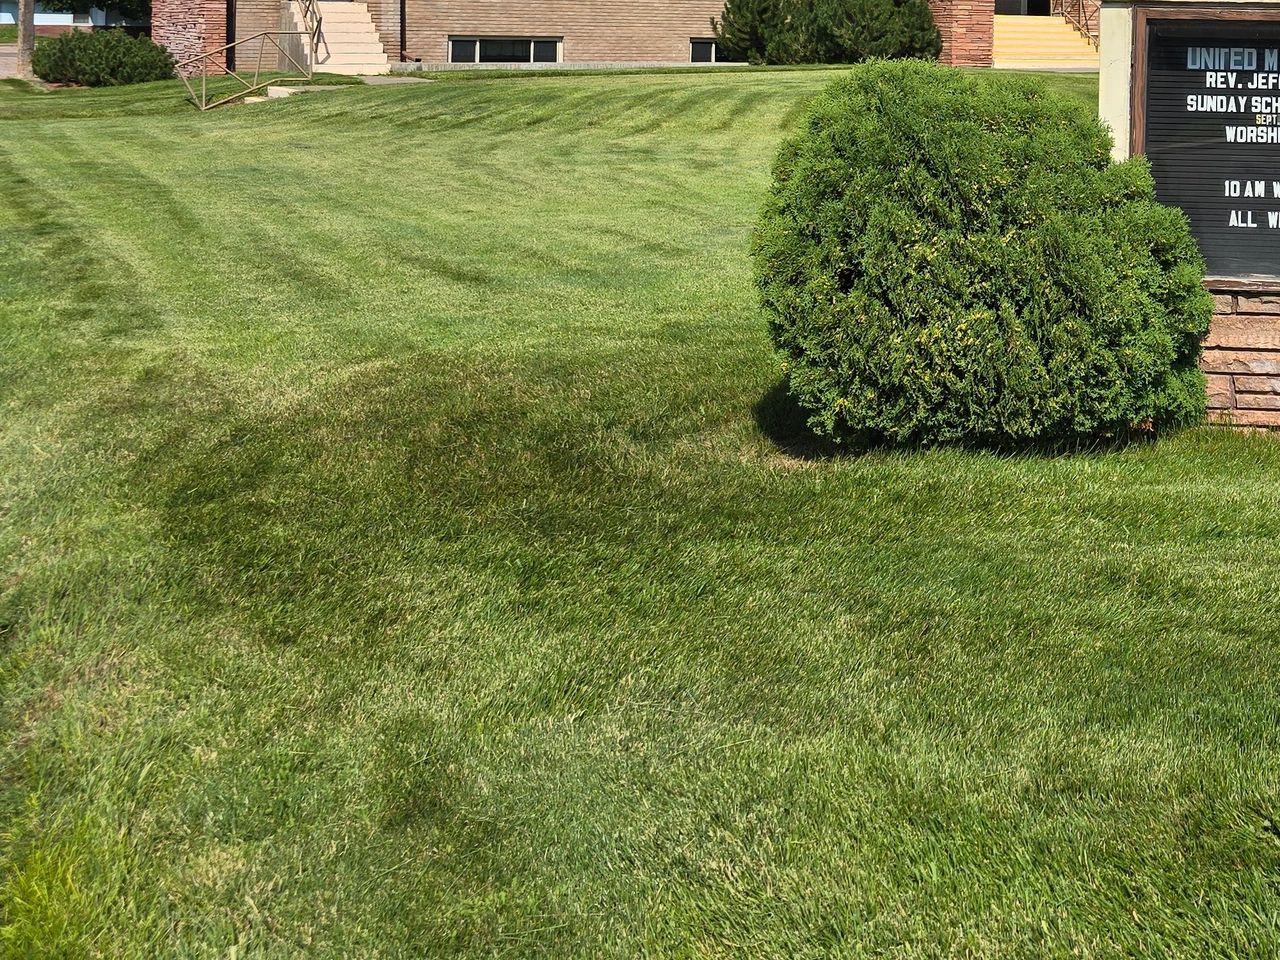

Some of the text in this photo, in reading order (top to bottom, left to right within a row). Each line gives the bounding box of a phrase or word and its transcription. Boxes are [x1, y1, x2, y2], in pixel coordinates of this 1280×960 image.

[1186, 47, 1257, 71] UNITED
[1206, 71, 1242, 89] REV.
[1186, 95, 1247, 113] SUNDAY
[1224, 180, 1240, 197] 10
[1244, 180, 1265, 198] AM
[1229, 210, 1257, 228] ALL
